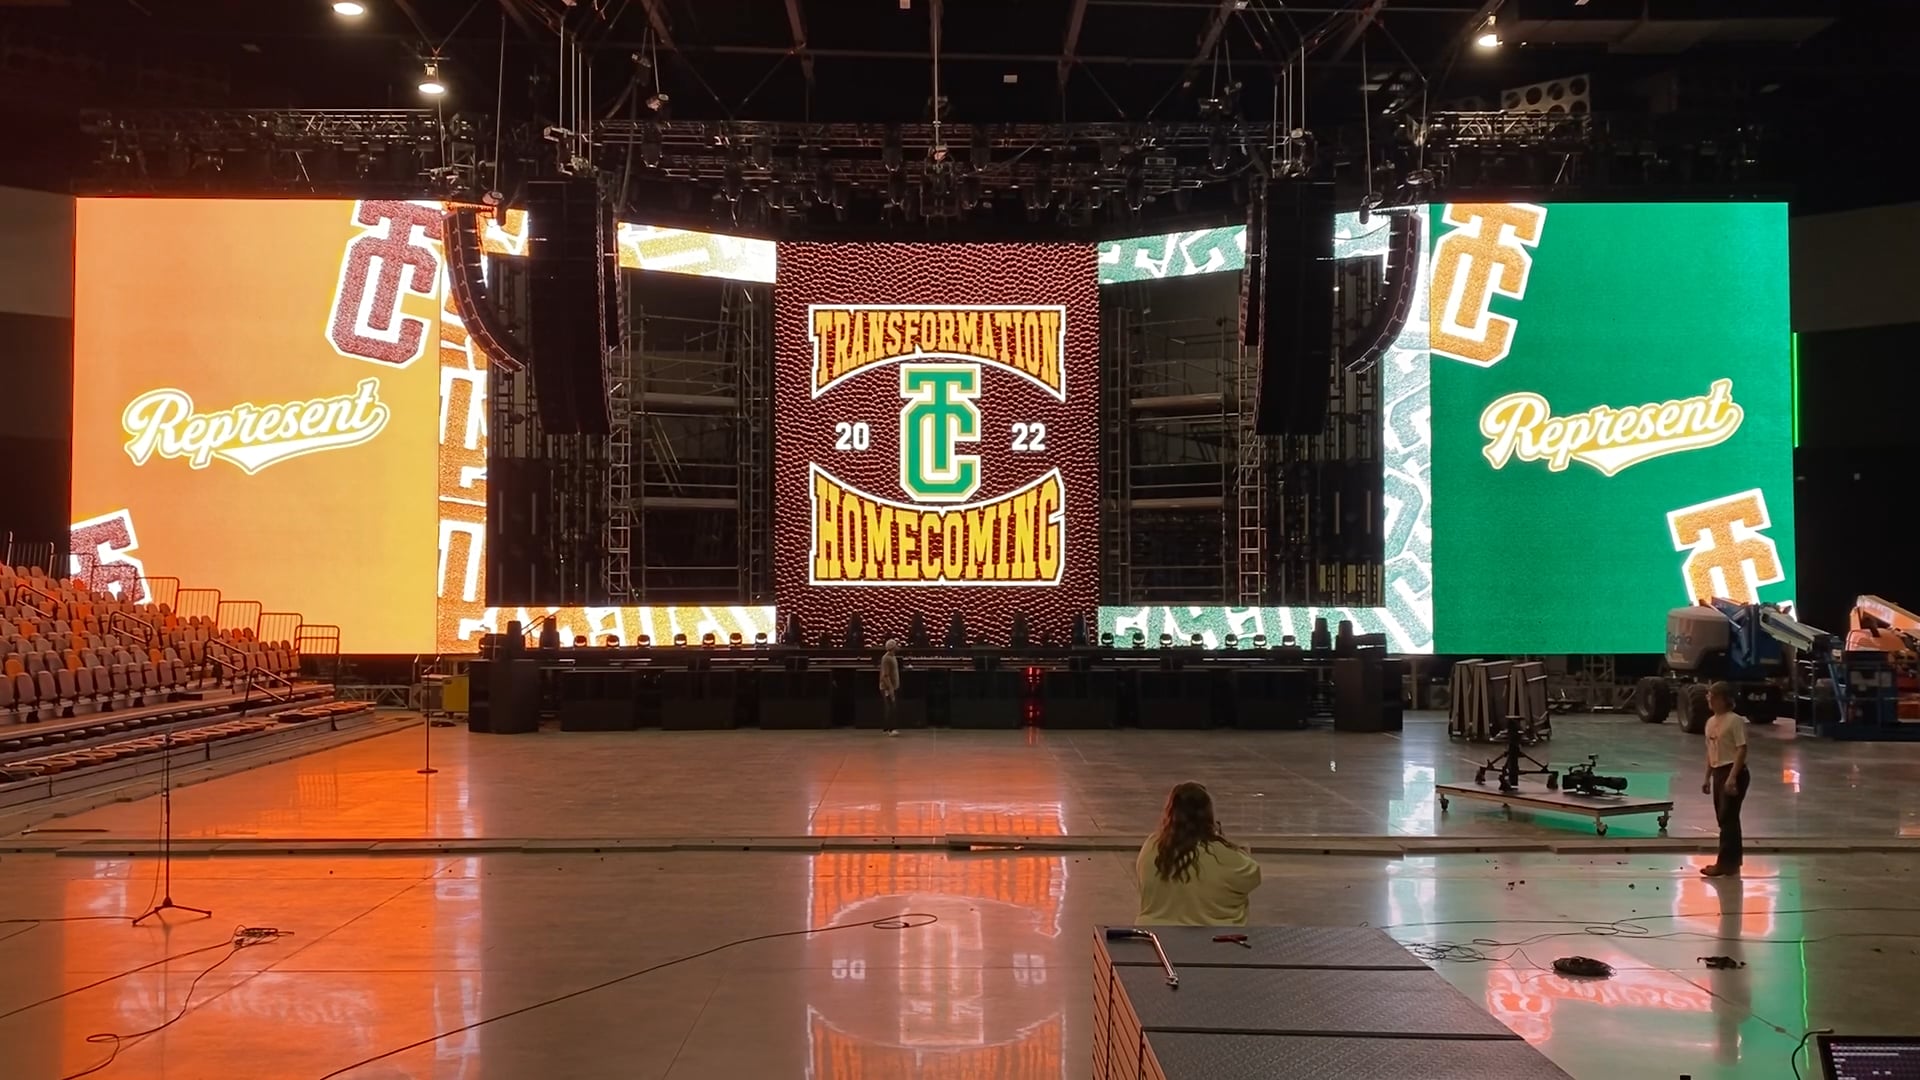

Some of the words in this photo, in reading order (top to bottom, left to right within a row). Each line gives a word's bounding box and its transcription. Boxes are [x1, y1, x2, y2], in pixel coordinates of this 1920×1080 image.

[814, 308, 1062, 396] TRANSFORMATION
[124, 377, 385, 472] Represent
[834, 422, 870, 451] 20
[1010, 422, 1046, 451] 22
[902, 366, 979, 499] TC
[1481, 378, 1738, 474] Represent
[813, 472, 1063, 582] HOMECOMING
